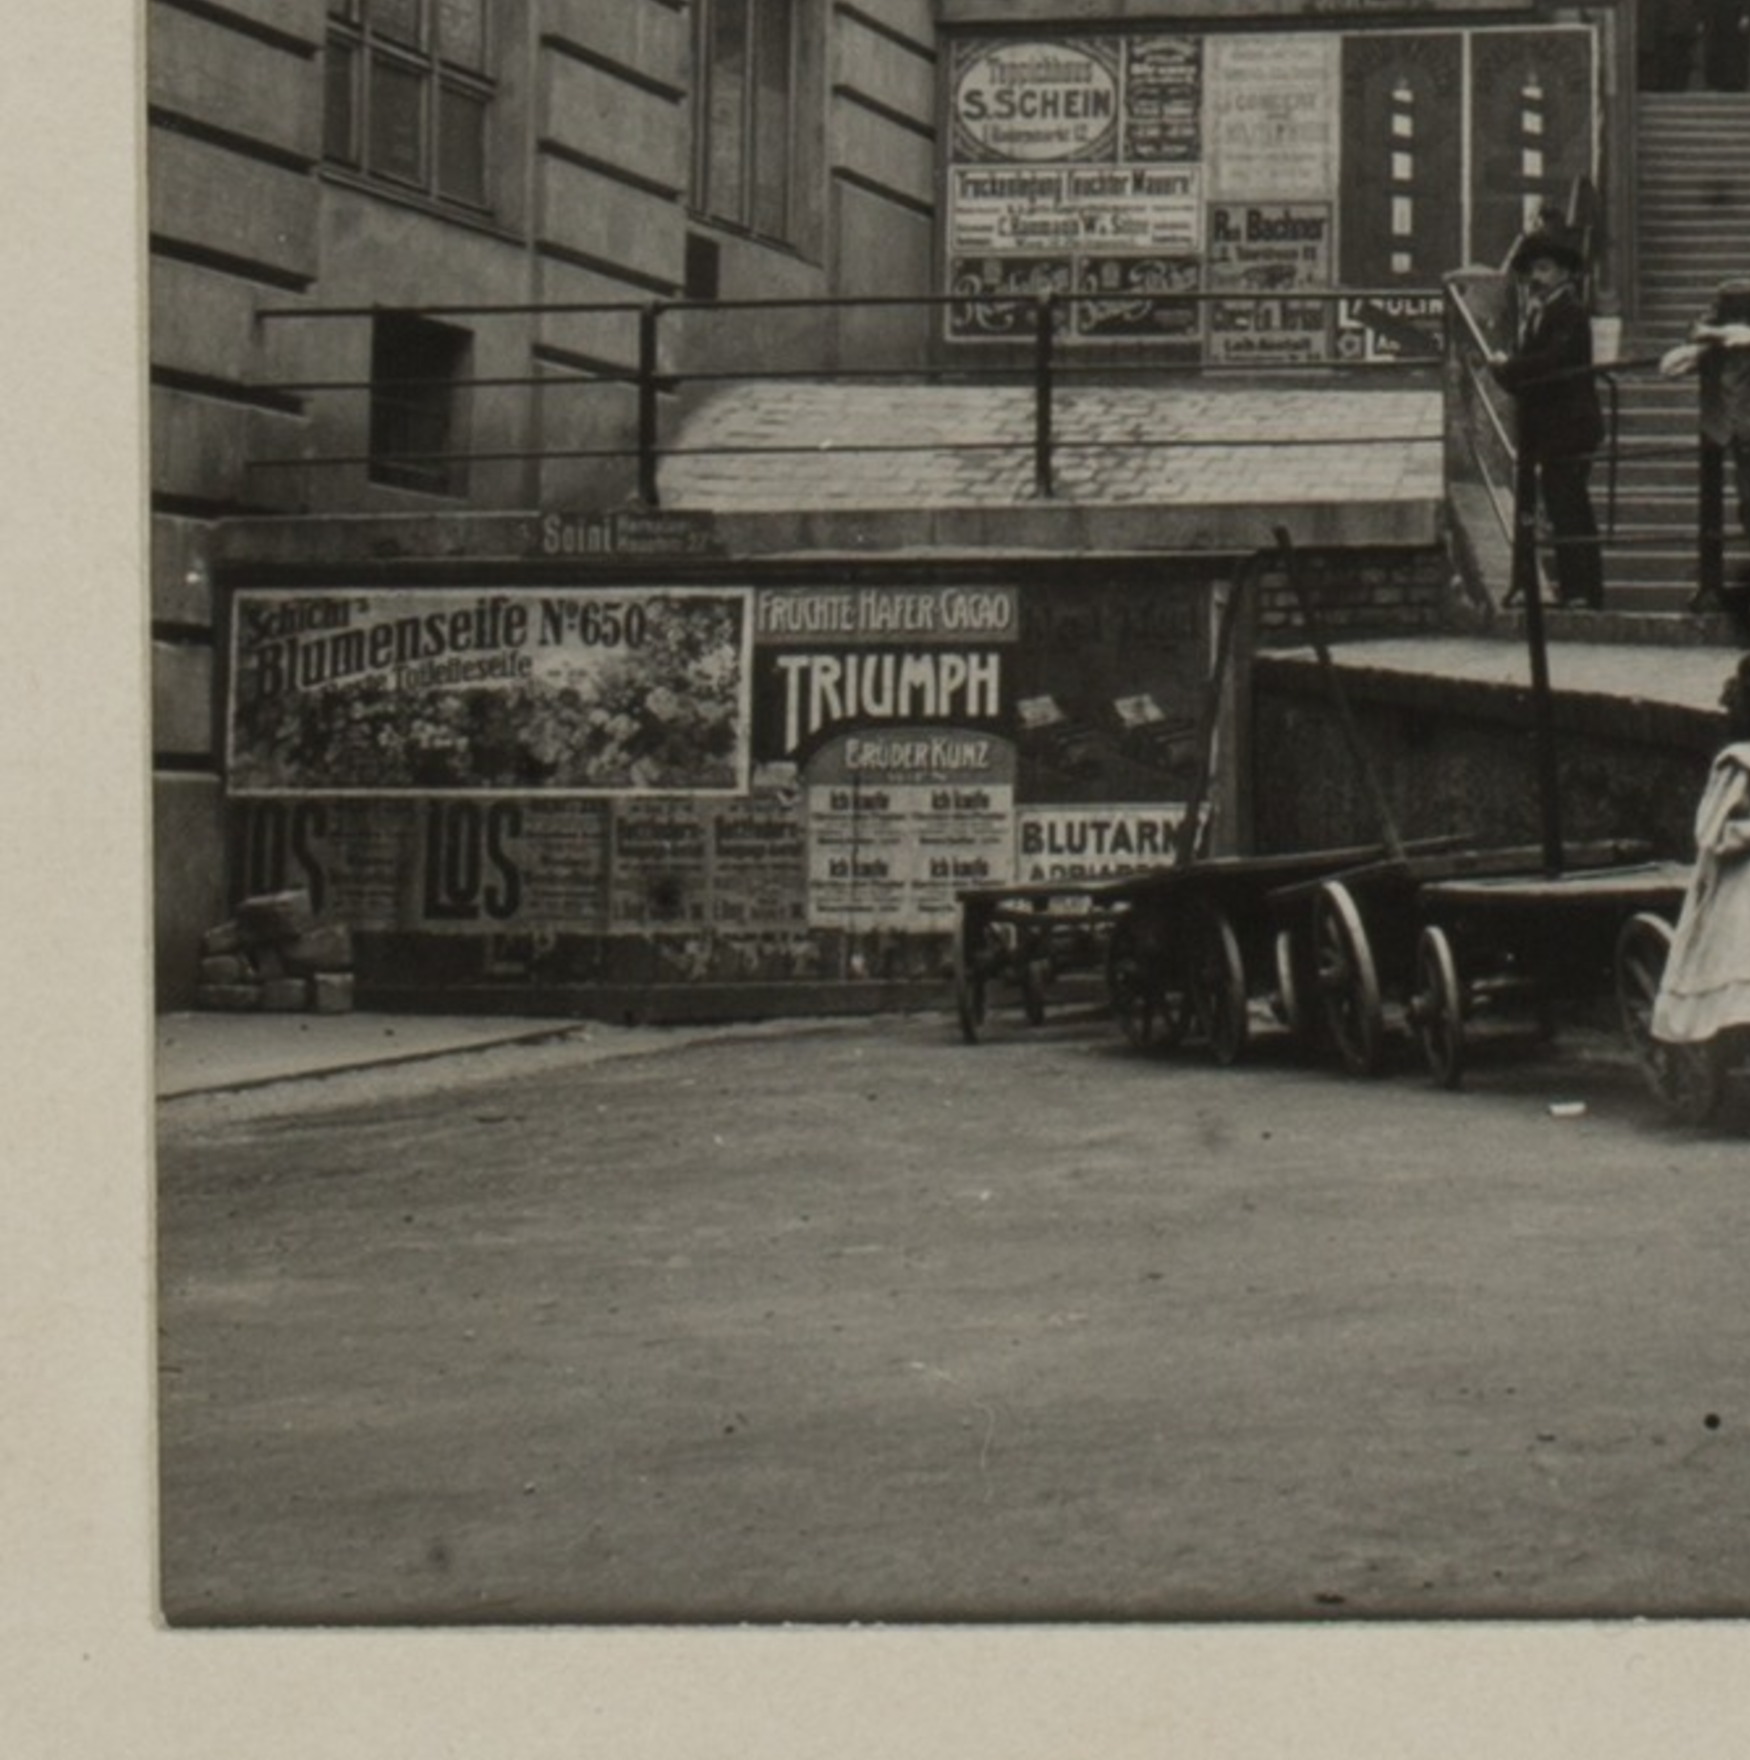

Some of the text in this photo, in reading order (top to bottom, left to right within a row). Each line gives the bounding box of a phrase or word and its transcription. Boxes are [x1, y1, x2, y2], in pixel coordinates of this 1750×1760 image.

[256, 596, 528, 699] Blumenseife
[776, 652, 1000, 754] TRIUMPH
[931, 735, 990, 769] KUNZ
[423, 799, 523, 920] LOS
